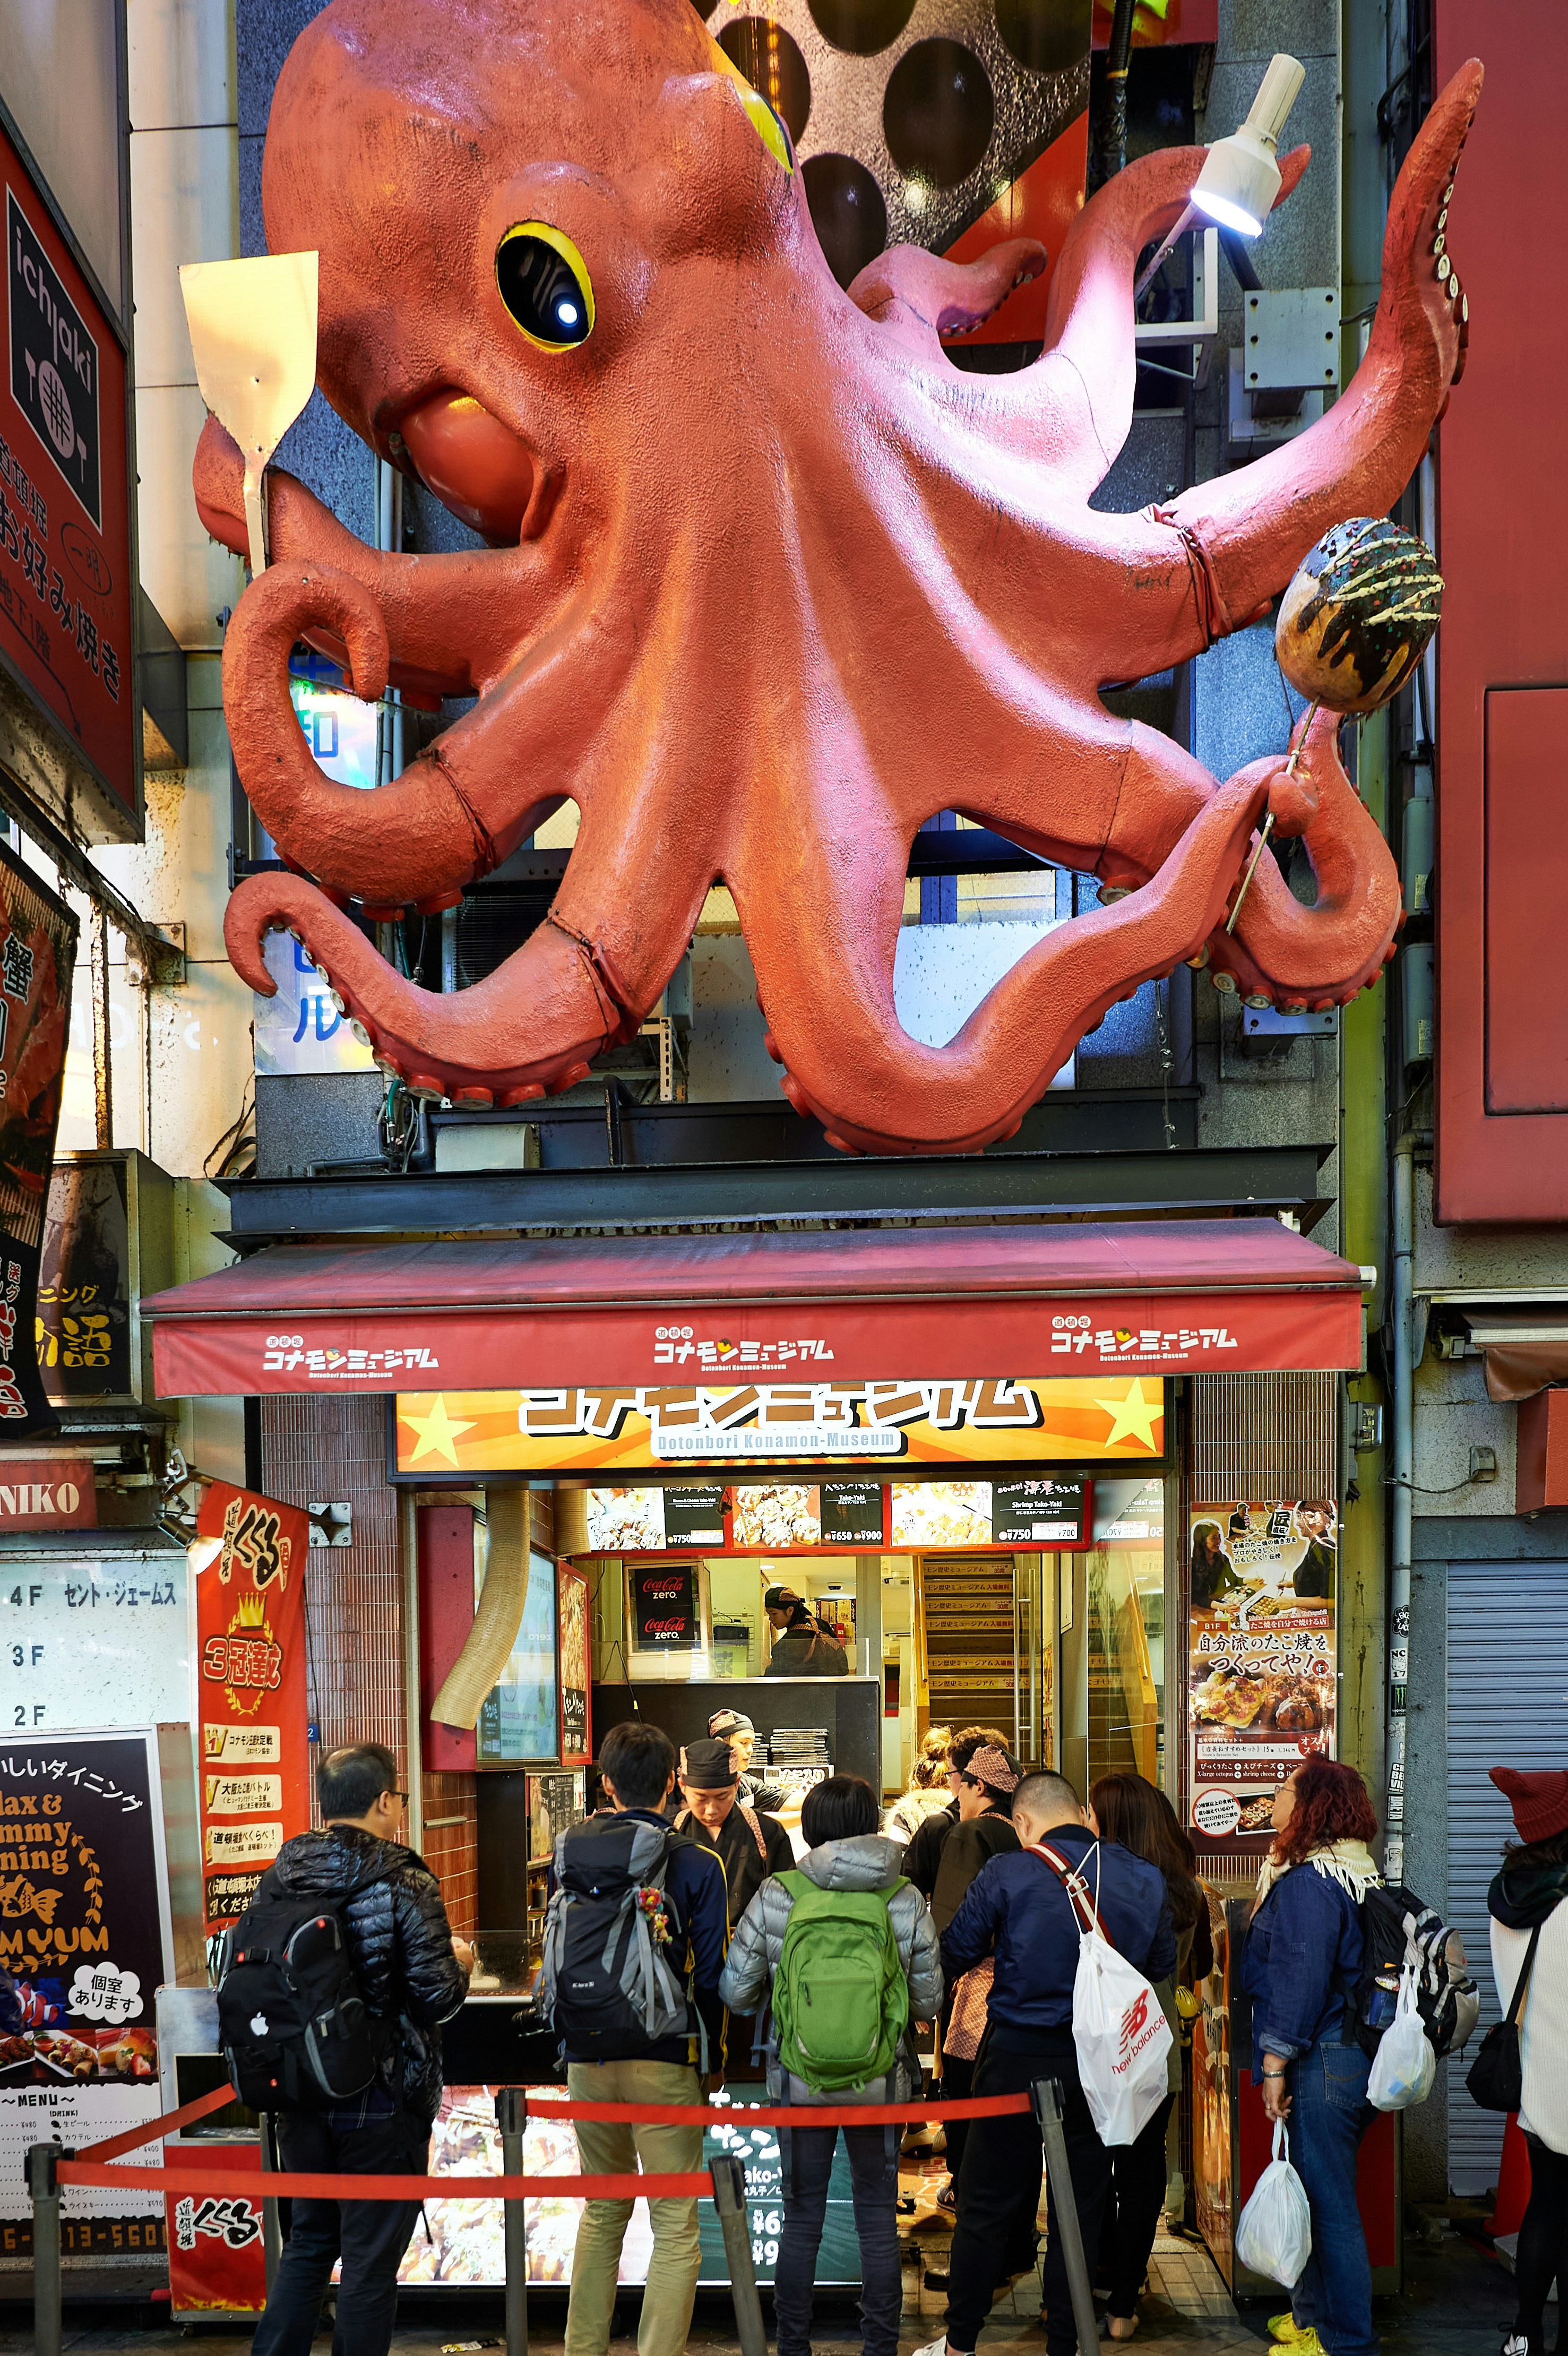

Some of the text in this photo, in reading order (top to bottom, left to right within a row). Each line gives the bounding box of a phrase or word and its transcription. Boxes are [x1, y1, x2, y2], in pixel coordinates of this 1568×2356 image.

[1052, 1315, 1091, 1329] 道頓堀
[266, 1335, 304, 1348] 道頓堀
[654, 1326, 693, 1339] 道頓堀
[1050, 1328, 1238, 1354] コナモンミュージアム
[262, 1347, 440, 1371] コナモンミュージアム
[653, 1339, 834, 1364] コナモンミュージアム
[658, 1432, 894, 1450] Dotonbori Konamon-Museum
[643, 1576, 685, 1593] Coca-Cola
[644, 1616, 686, 1633] Coca-Cola
[1250, 1617, 1327, 1629] たこ焼を自分で焼ける店
[1200, 1633, 1326, 1652] 自分流のたこ焼を
[27, 1925, 109, 1954] YUM
[91, 1974, 123, 1994] 個室
[75, 1990, 135, 2014] あります
[1111, 2015, 1166, 2075] new balance
[193, 2200, 259, 2245] くくる
